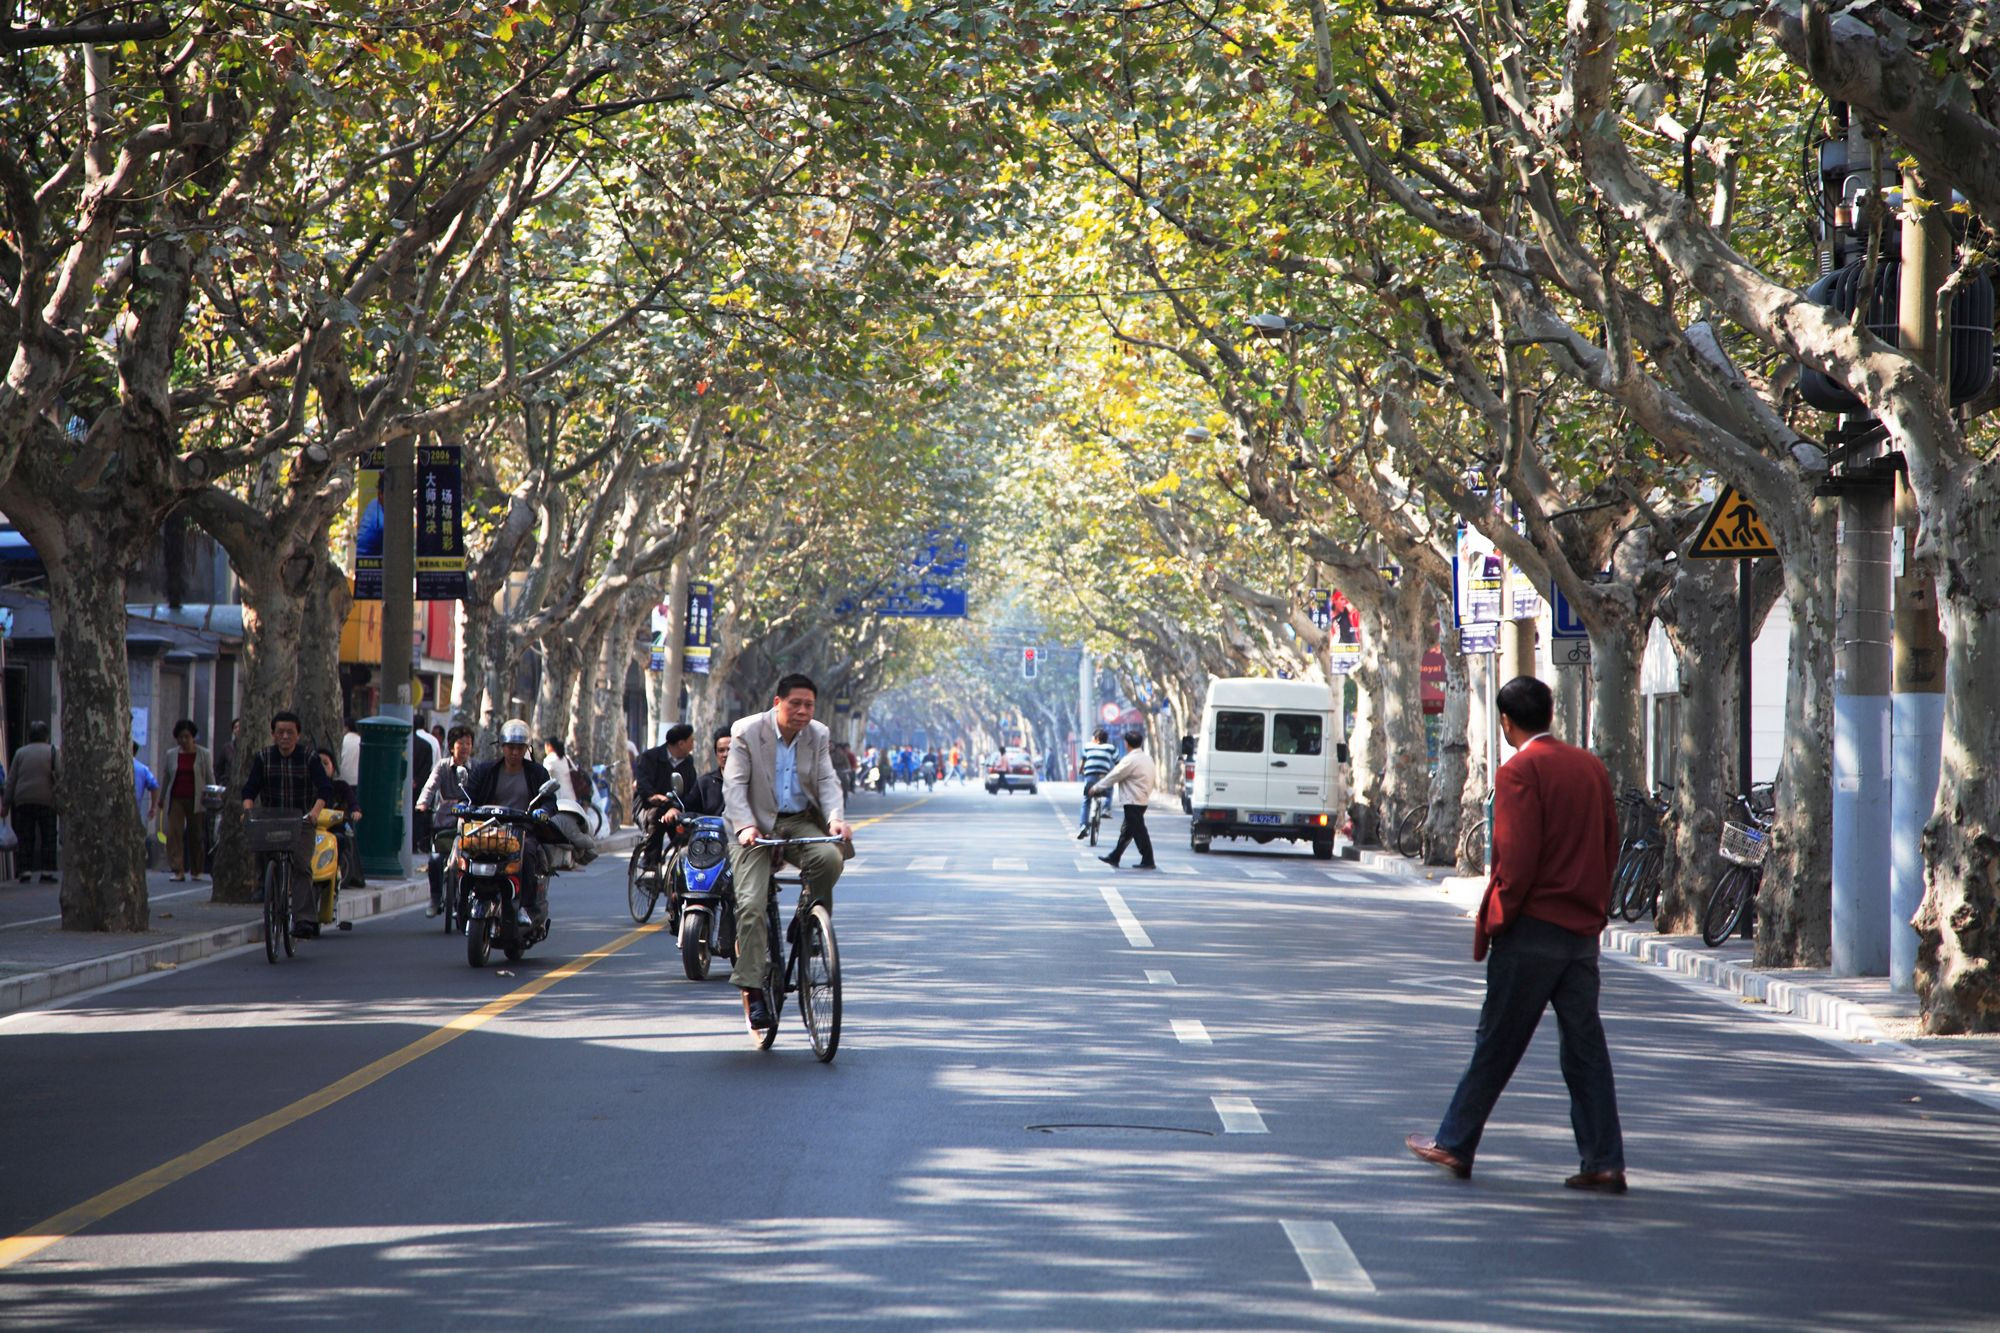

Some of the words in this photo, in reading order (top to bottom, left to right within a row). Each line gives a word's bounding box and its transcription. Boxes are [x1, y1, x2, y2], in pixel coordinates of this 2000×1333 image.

[431, 450, 449, 460] 2006
[425, 472, 437, 534] 大师对决
[441, 489, 453, 551] 场场精彩
